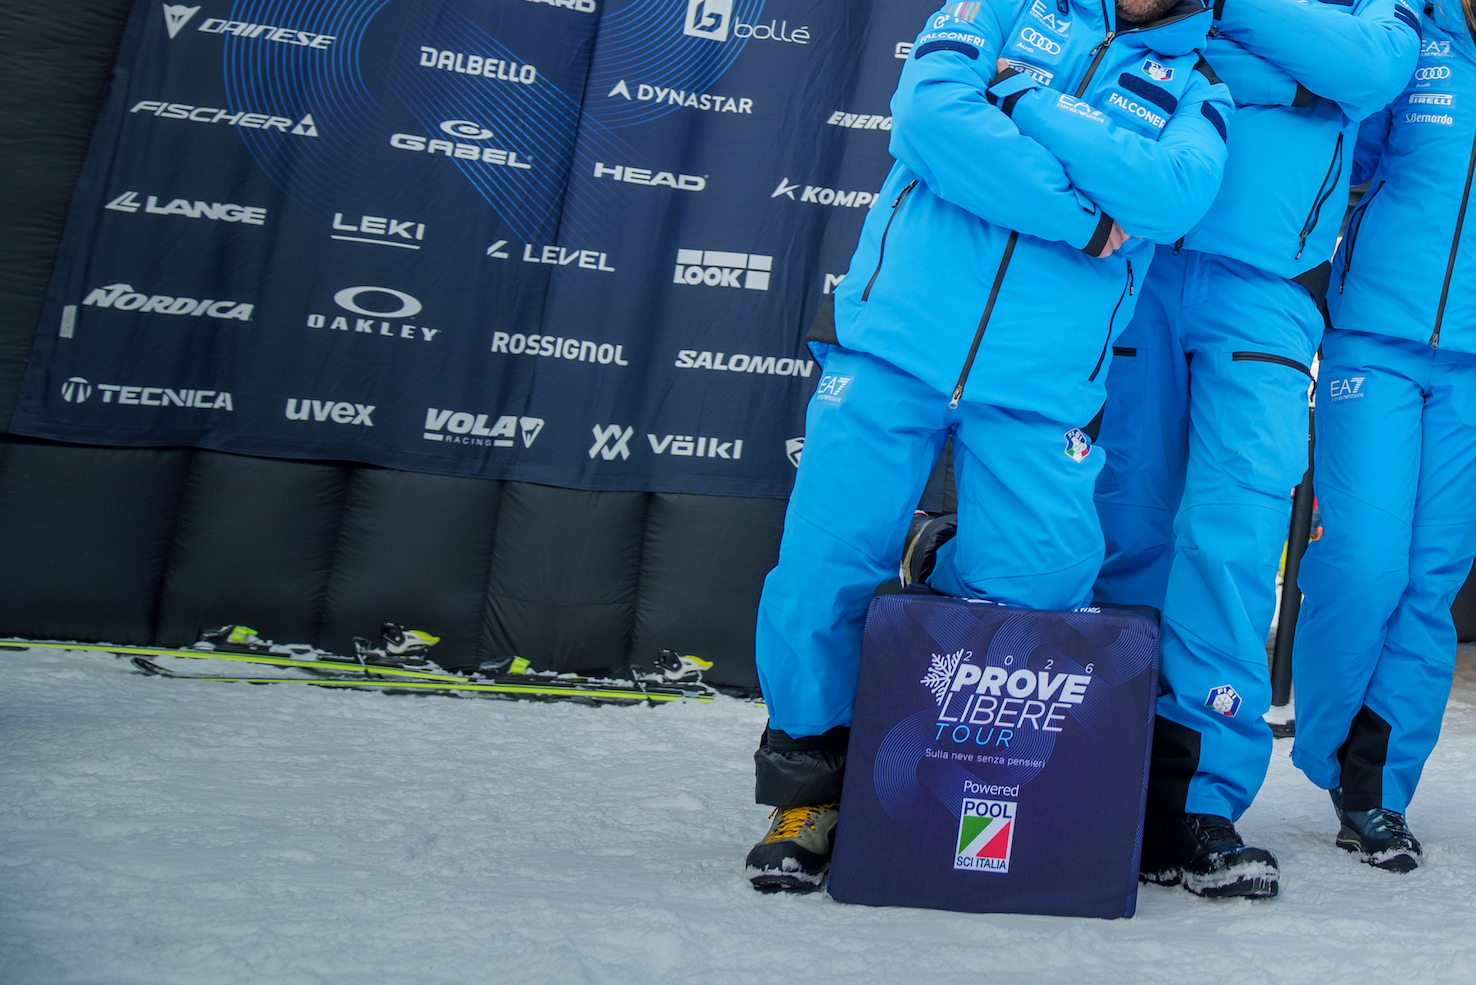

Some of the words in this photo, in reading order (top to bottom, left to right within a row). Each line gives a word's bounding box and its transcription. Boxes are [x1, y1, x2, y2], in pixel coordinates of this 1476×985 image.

[198, 18, 336, 50] DAINESE
[734, 17, 810, 44] bollé
[920, 32, 985, 47] FALCONERI
[1016, 42, 1035, 54] Audi
[1421, 40, 1450, 53] EA7
[420, 45, 536, 85] DALBELLO
[637, 83, 753, 114] DYNASTAR
[1409, 94, 1453, 105] PIRELLI
[130, 100, 293, 133] FISCHER
[390, 132, 532, 170] GABEL
[594, 162, 707, 192] HEAD
[145, 195, 267, 226] LANGE
[332, 212, 425, 241] LEKI
[523, 243, 615, 273] LEVEL
[673, 264, 744, 289] LOOK
[82, 283, 254, 322] NORDICA
[306, 314, 438, 341] OAKLEY
[491, 331, 629, 366] ROSSIGNOL
[674, 349, 814, 378] SALOMON
[97, 383, 234, 412] TECNICA
[818, 375, 850, 395] EA7
[1330, 377, 1365, 395] EA7
[285, 397, 376, 427] uvex
[425, 407, 518, 437] VOLA
[445, 435, 492, 447] RACING
[951, 664, 1092, 704] PROVE
[1217, 687, 1236, 699] FISI
[938, 692, 1072, 732] LIBERE
[935, 723, 1014, 747] TOUR
[925, 748, 949, 760] Sulla
[951, 752, 974, 761] neve
[976, 754, 1005, 765] senza
[1007, 757, 1046, 769] pensieri
[963, 780, 1019, 797] Powered
[963, 801, 1013, 819] POOL
[956, 855, 974, 867] SCI
[975, 857, 1007, 870] ITALIA
